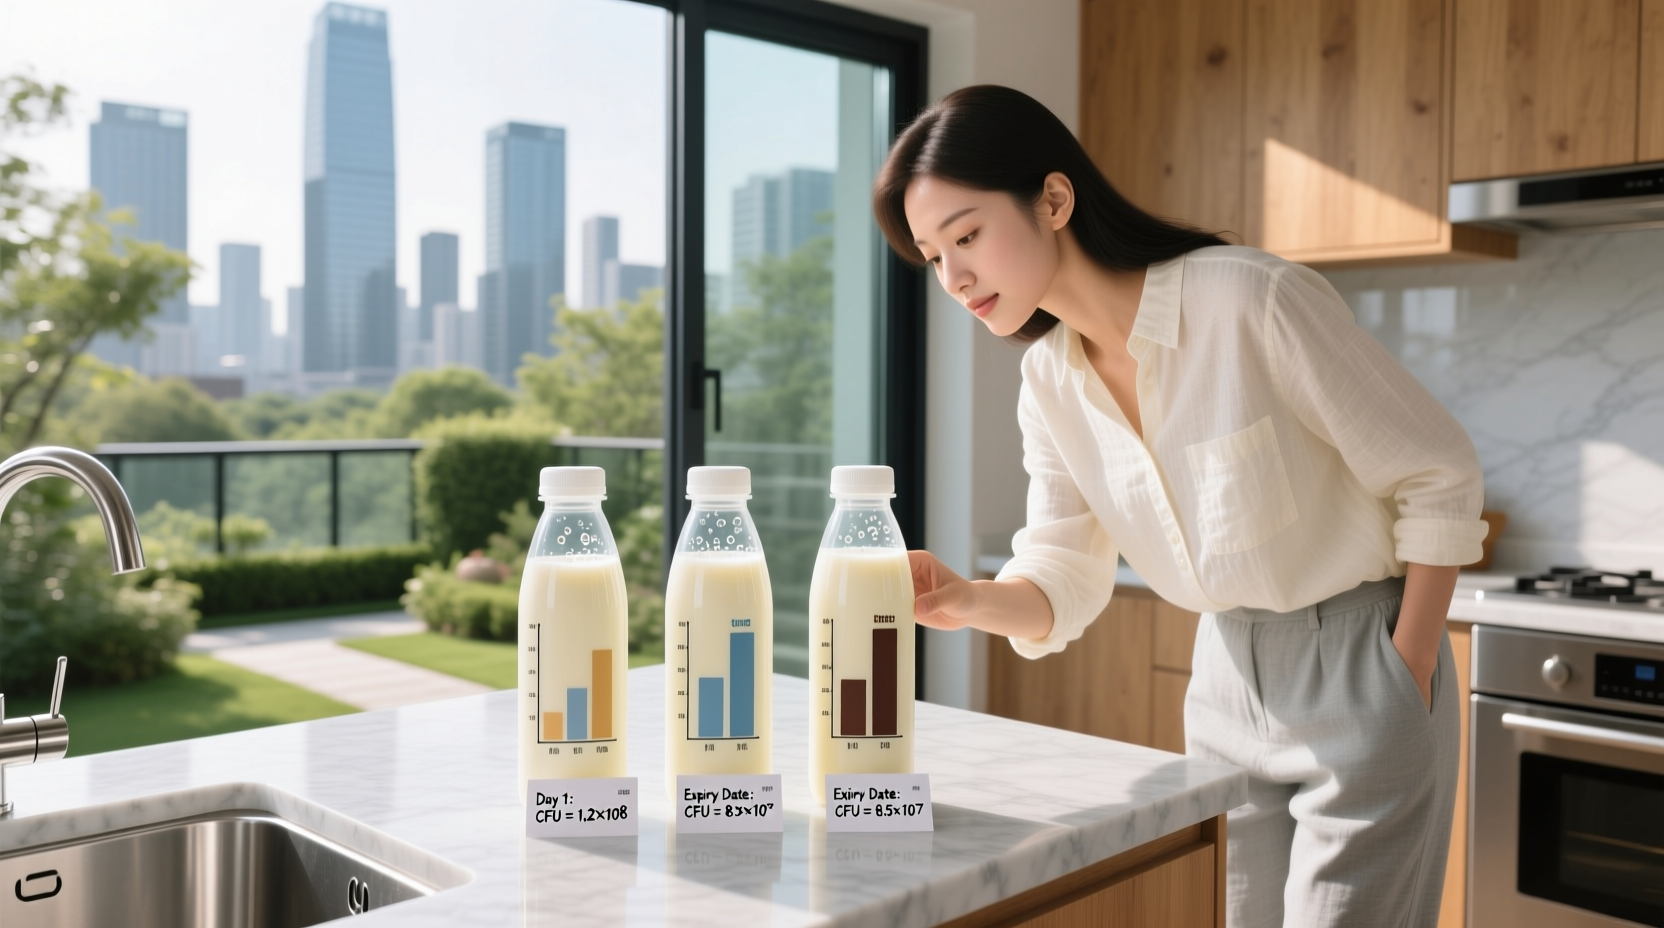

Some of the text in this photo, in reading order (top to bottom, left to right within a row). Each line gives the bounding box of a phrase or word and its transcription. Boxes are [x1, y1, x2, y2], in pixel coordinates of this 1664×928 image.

[536, 792, 574, 808] Day 1:
[722, 787, 754, 801] Date:
[869, 787, 900, 800] Date:
[535, 809, 561, 823] CFU
[684, 805, 710, 818] CFU
[713, 808, 722, 816] =
[835, 804, 860, 817] CFU
